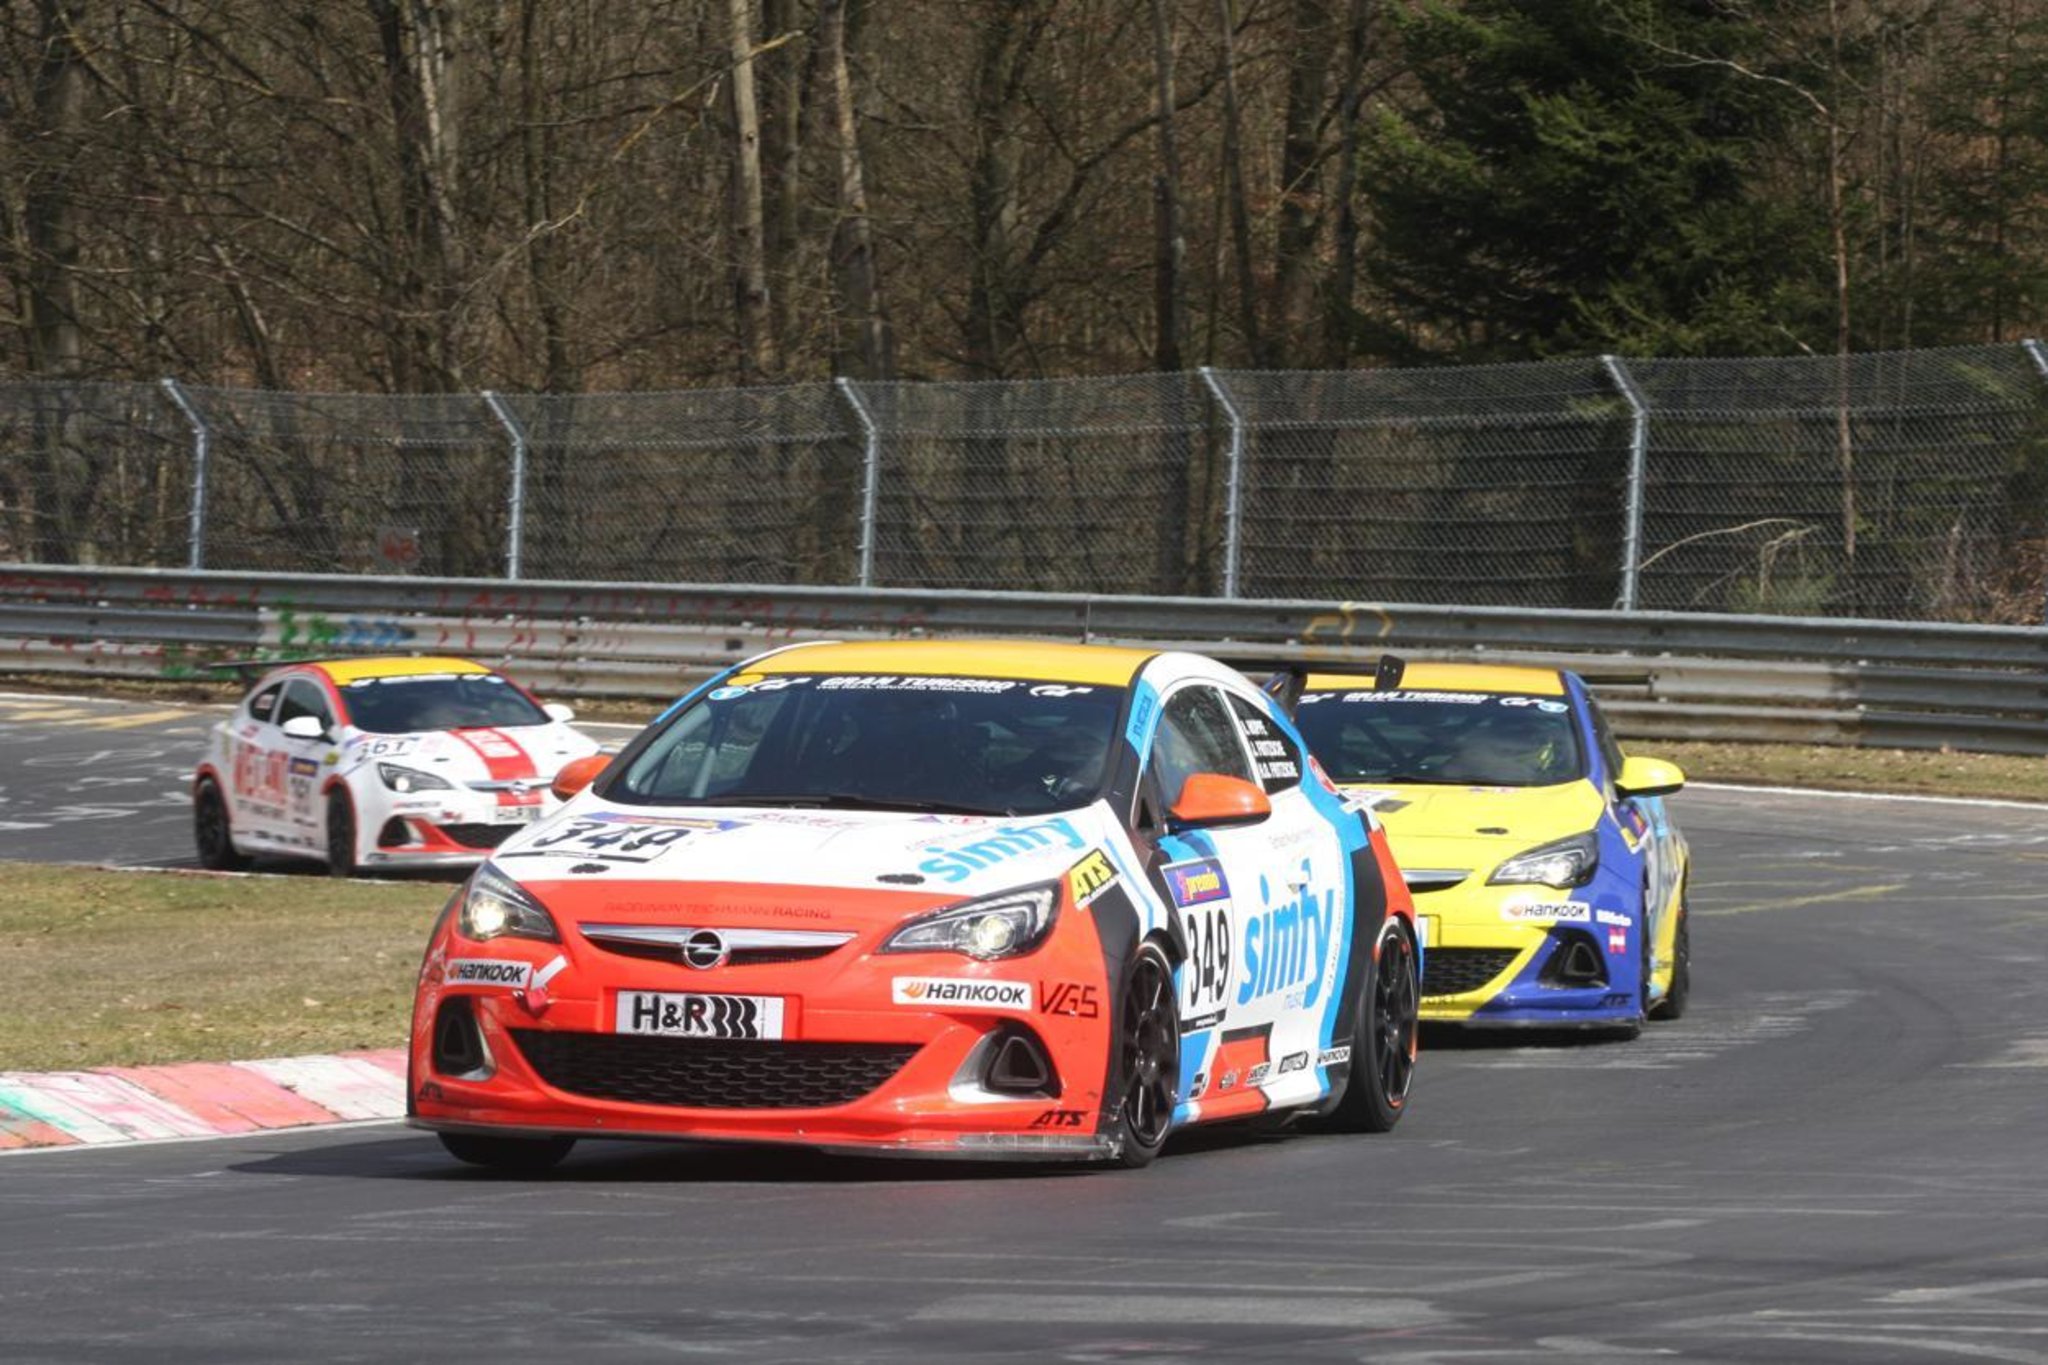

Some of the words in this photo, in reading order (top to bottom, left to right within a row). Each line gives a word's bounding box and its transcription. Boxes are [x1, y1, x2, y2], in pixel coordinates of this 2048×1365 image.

[533, 822, 691, 852] 349
[772, 907, 832, 920] RACING
[1187, 908, 1230, 1008] 349
[1027, 1110, 1088, 1130] ATS
